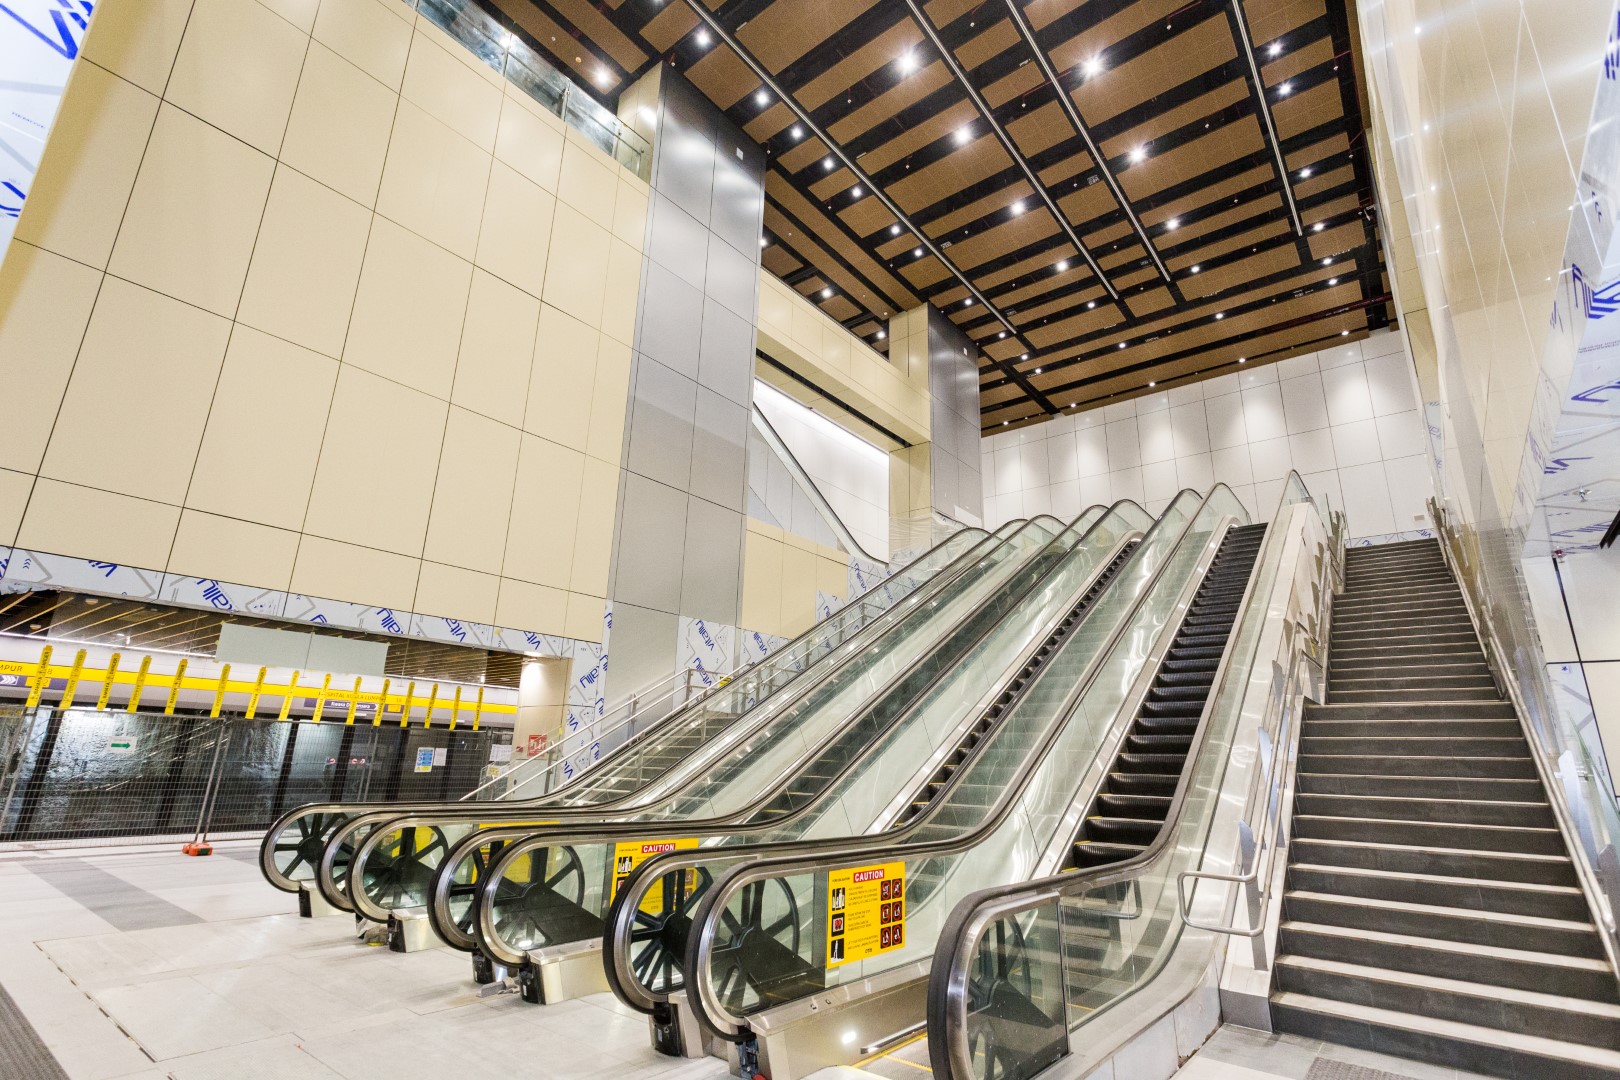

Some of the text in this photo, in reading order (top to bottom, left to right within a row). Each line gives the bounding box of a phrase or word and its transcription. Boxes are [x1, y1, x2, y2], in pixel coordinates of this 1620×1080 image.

[376, 608, 404, 634] ally
[524, 631, 540, 650] vit
[695, 620, 715, 652] vitally
[854, 870, 884, 882] CAUTION
